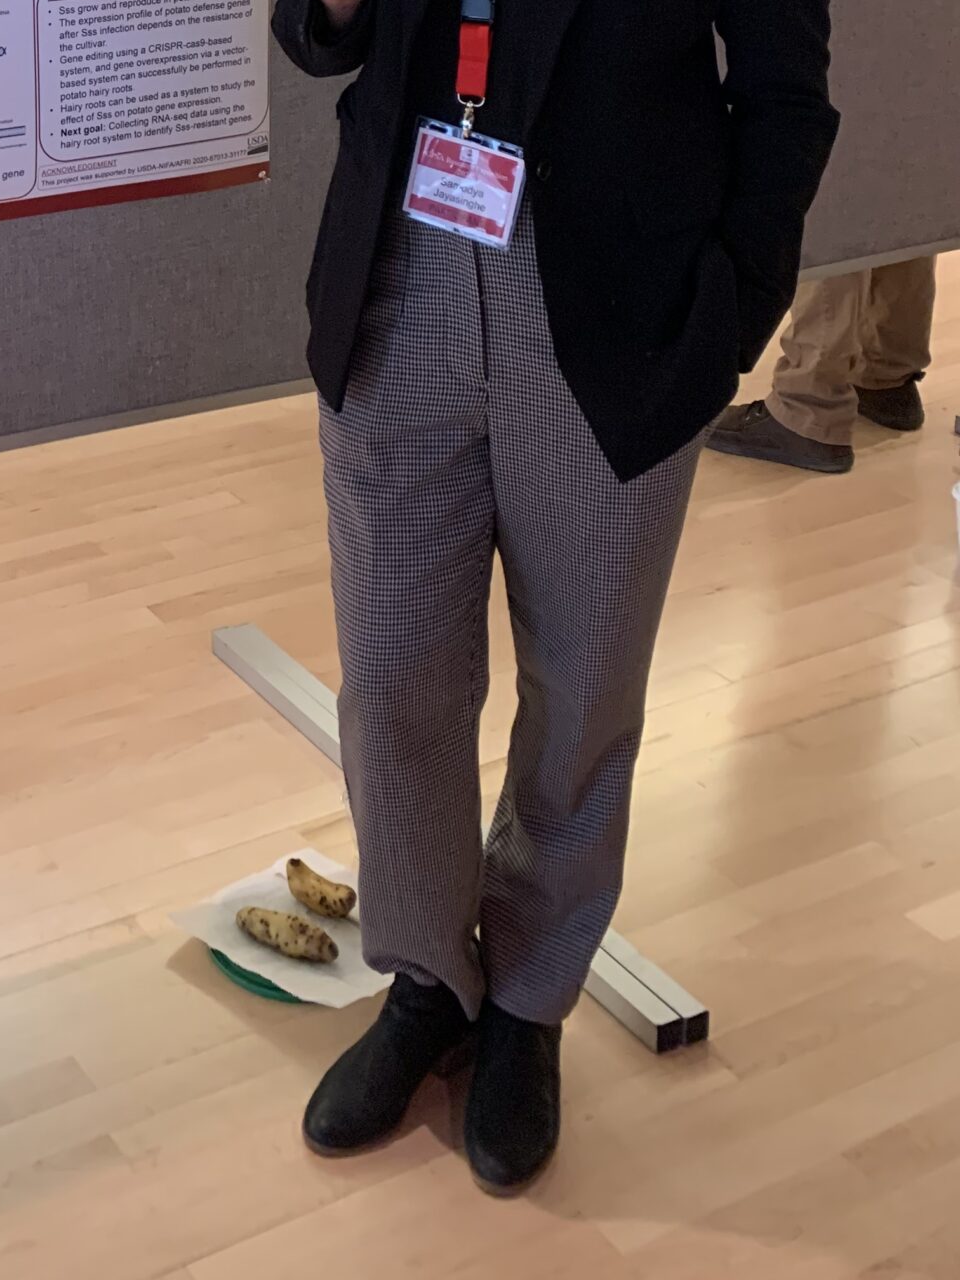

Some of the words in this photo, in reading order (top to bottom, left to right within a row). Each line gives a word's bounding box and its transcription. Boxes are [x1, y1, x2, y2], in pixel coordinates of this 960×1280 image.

[58, 5, 76, 15] Sss
[77, 4, 99, 15] grow
[100, 0, 117, 11] and
[1, 169, 25, 181] gene
